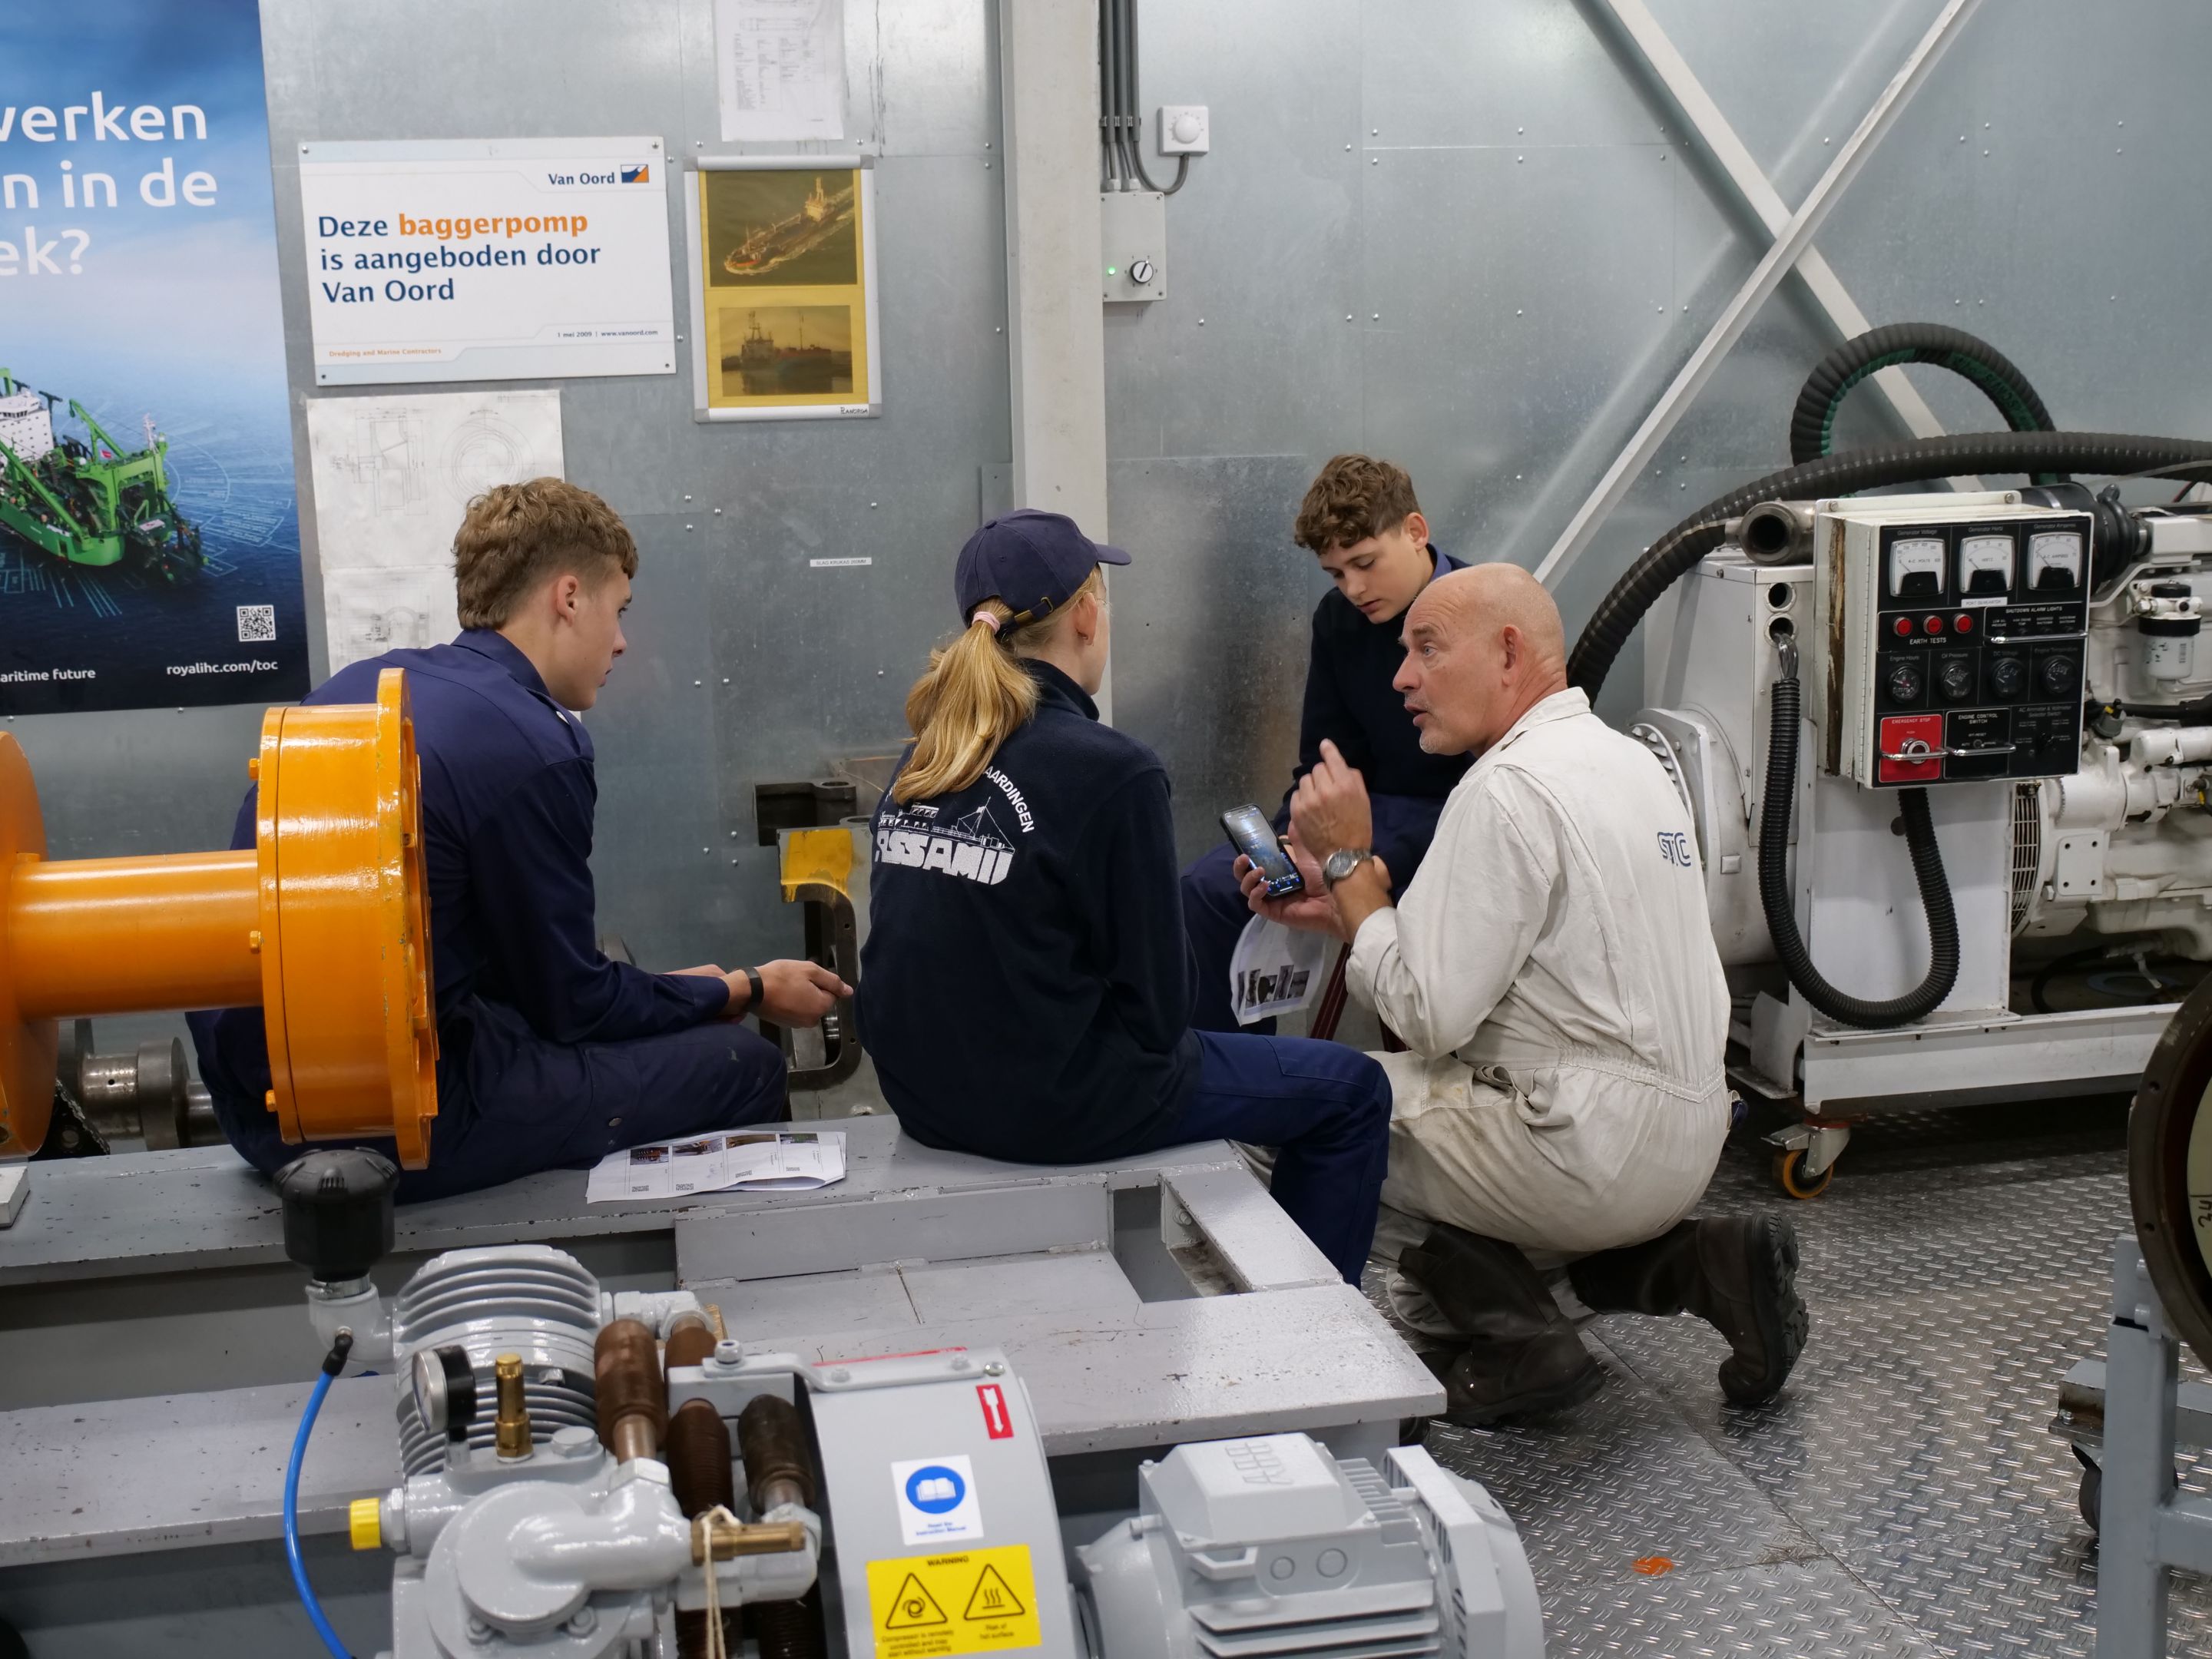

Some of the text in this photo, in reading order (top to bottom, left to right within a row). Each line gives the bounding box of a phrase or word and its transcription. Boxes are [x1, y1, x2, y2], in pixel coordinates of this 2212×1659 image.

[60, 160, 118, 207] in
[140, 157, 217, 207] de
[548, 172, 615, 185] Van Oord
[319, 213, 588, 240] Deze baggerpomp
[321, 243, 601, 273] is aangeboden door
[323, 278, 454, 303] Van Oord
[53, 667, 96, 680] future
[167, 660, 278, 676] royalihc.com/toc
[1657, 832, 1691, 866] STC
[927, 1555, 969, 1567] WARNING
